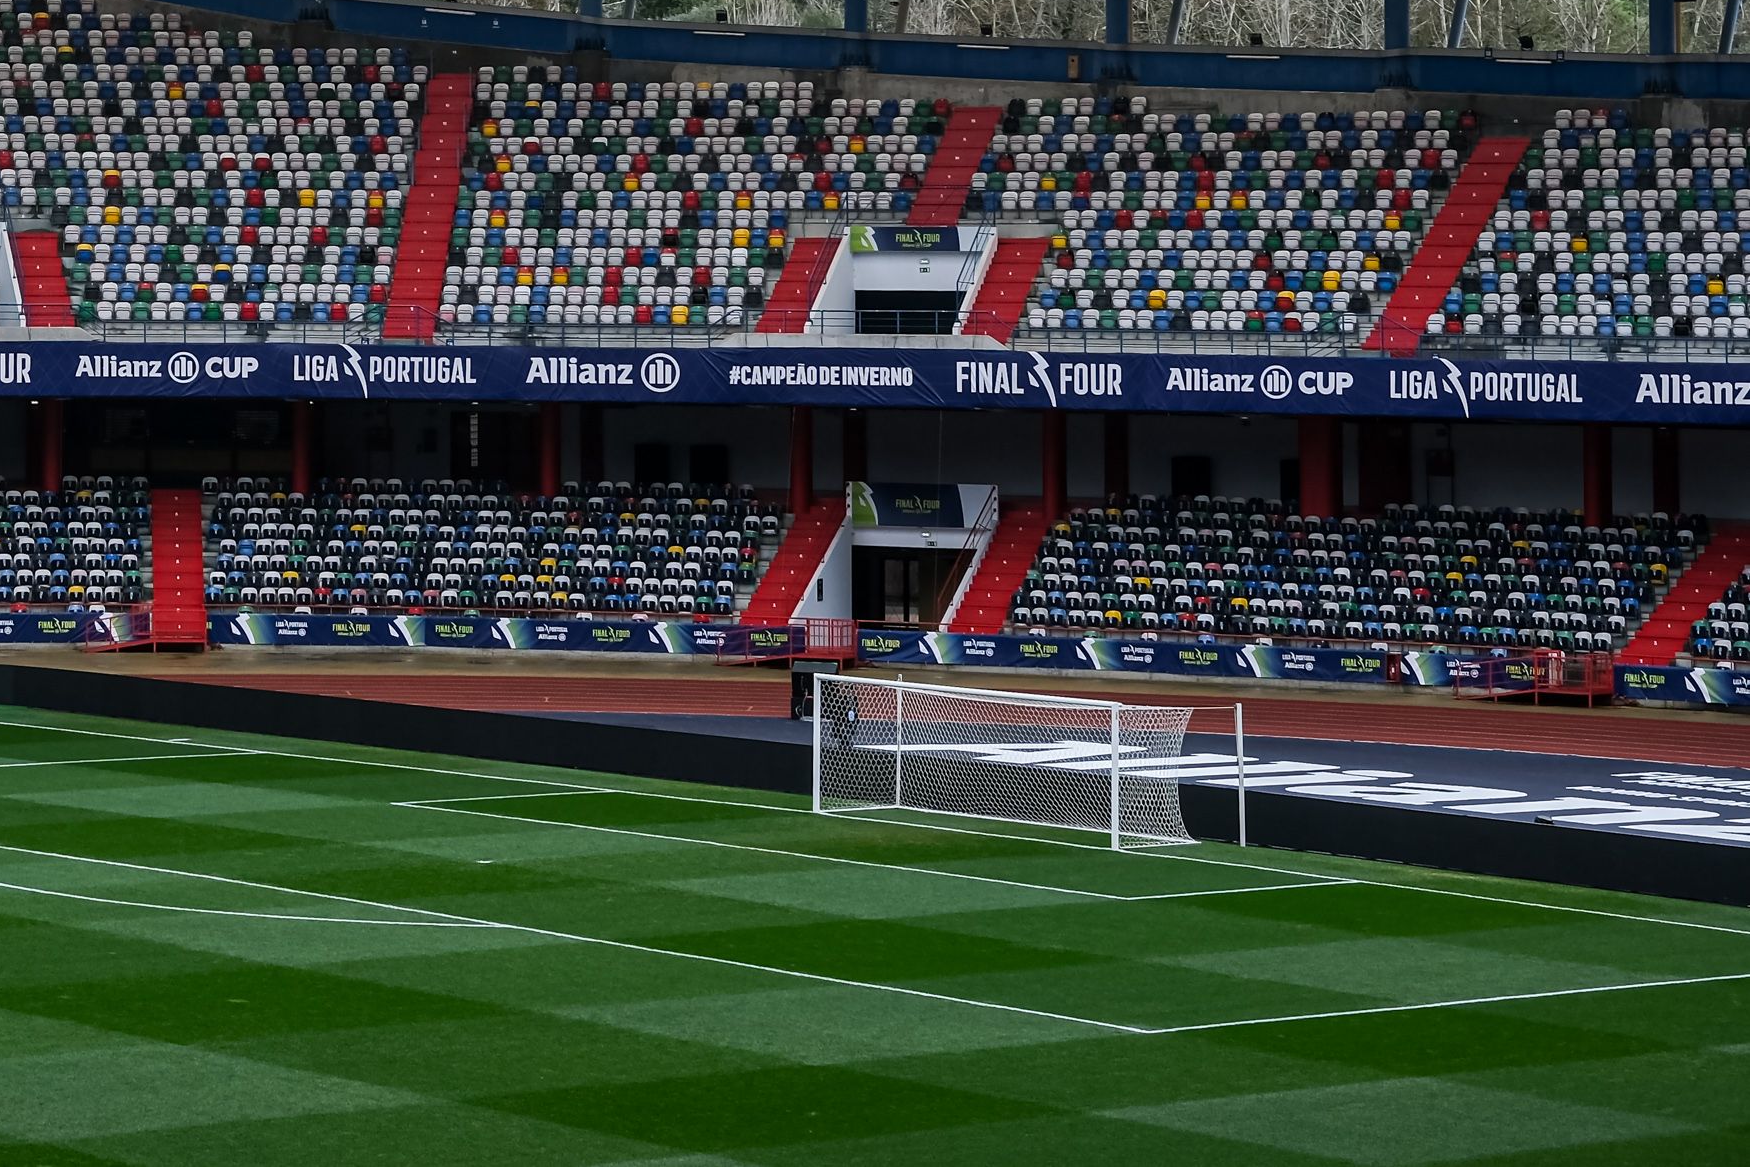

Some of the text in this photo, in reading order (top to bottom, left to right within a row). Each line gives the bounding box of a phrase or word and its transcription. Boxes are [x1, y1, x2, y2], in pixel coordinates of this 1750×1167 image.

[896, 234, 914, 242] FINAL
[75, 355, 259, 379] Allianz CUP
[294, 355, 477, 384] LIGA PORTUGAL
[526, 357, 633, 384] Allianz
[956, 362, 1122, 395] FINAL FOUR
[1166, 368, 1354, 395] Allianz CUP
[1390, 370, 1583, 403] LIGA PORTUGAL
[1635, 373, 1750, 405] Allianz
[895, 499, 940, 508] FINAL FOUR
[332, 623, 371, 632] FINAL FOUR
[435, 625, 473, 634] FINAL FOUR
[861, 639, 901, 649] FINAL FOUR
[1020, 645, 1059, 654] FINAL FOUR
[1179, 651, 1218, 661] FINAL FOUR
[1341, 658, 1380, 668] FINAL FOUR
[1624, 673, 1665, 684] FINAL FOUR
